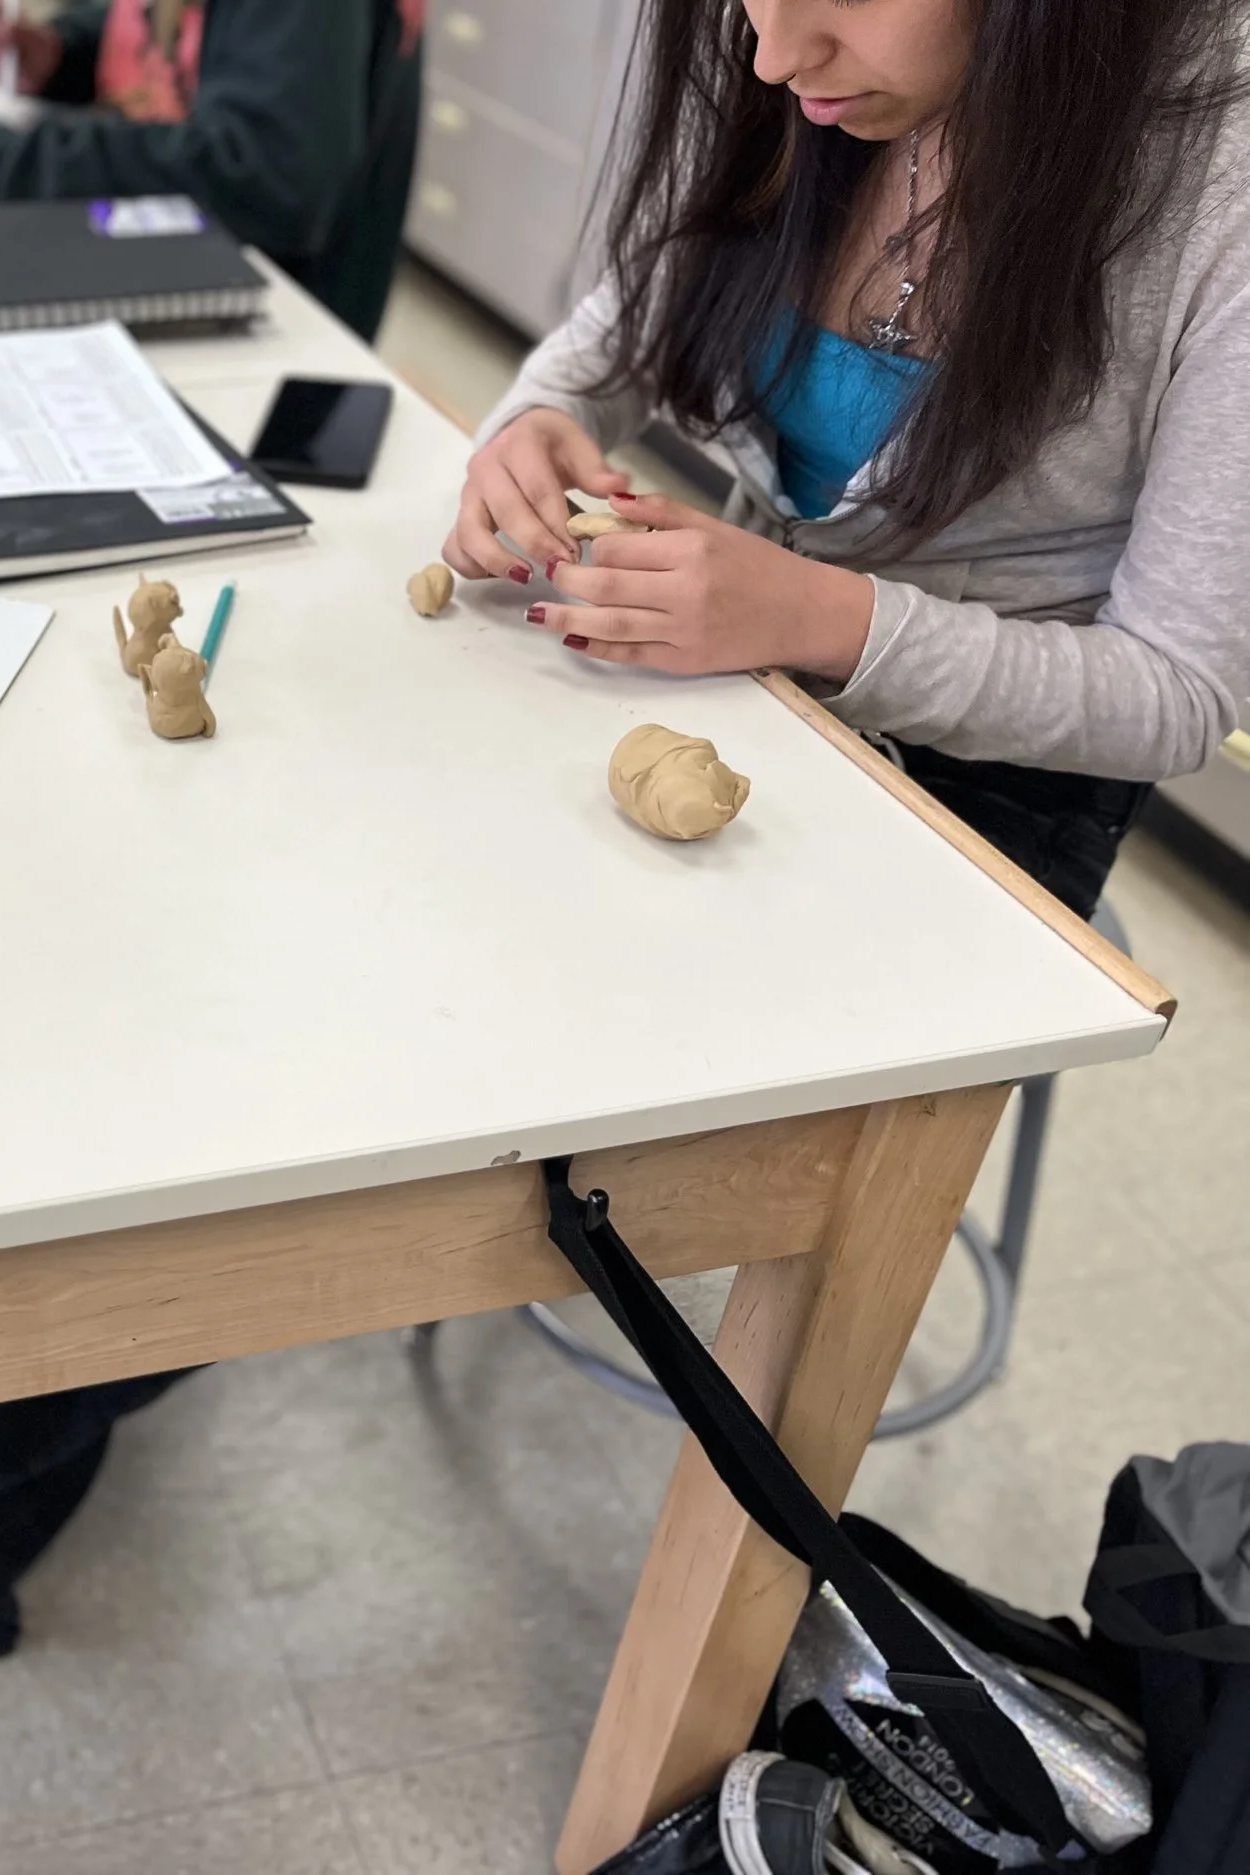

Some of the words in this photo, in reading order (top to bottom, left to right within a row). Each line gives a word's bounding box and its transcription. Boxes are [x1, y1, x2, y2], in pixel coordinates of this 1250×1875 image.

[853, 1760, 935, 1834] SECRET
[875, 1718, 975, 1806] LONDON
[891, 1767, 990, 1847] FASHION
